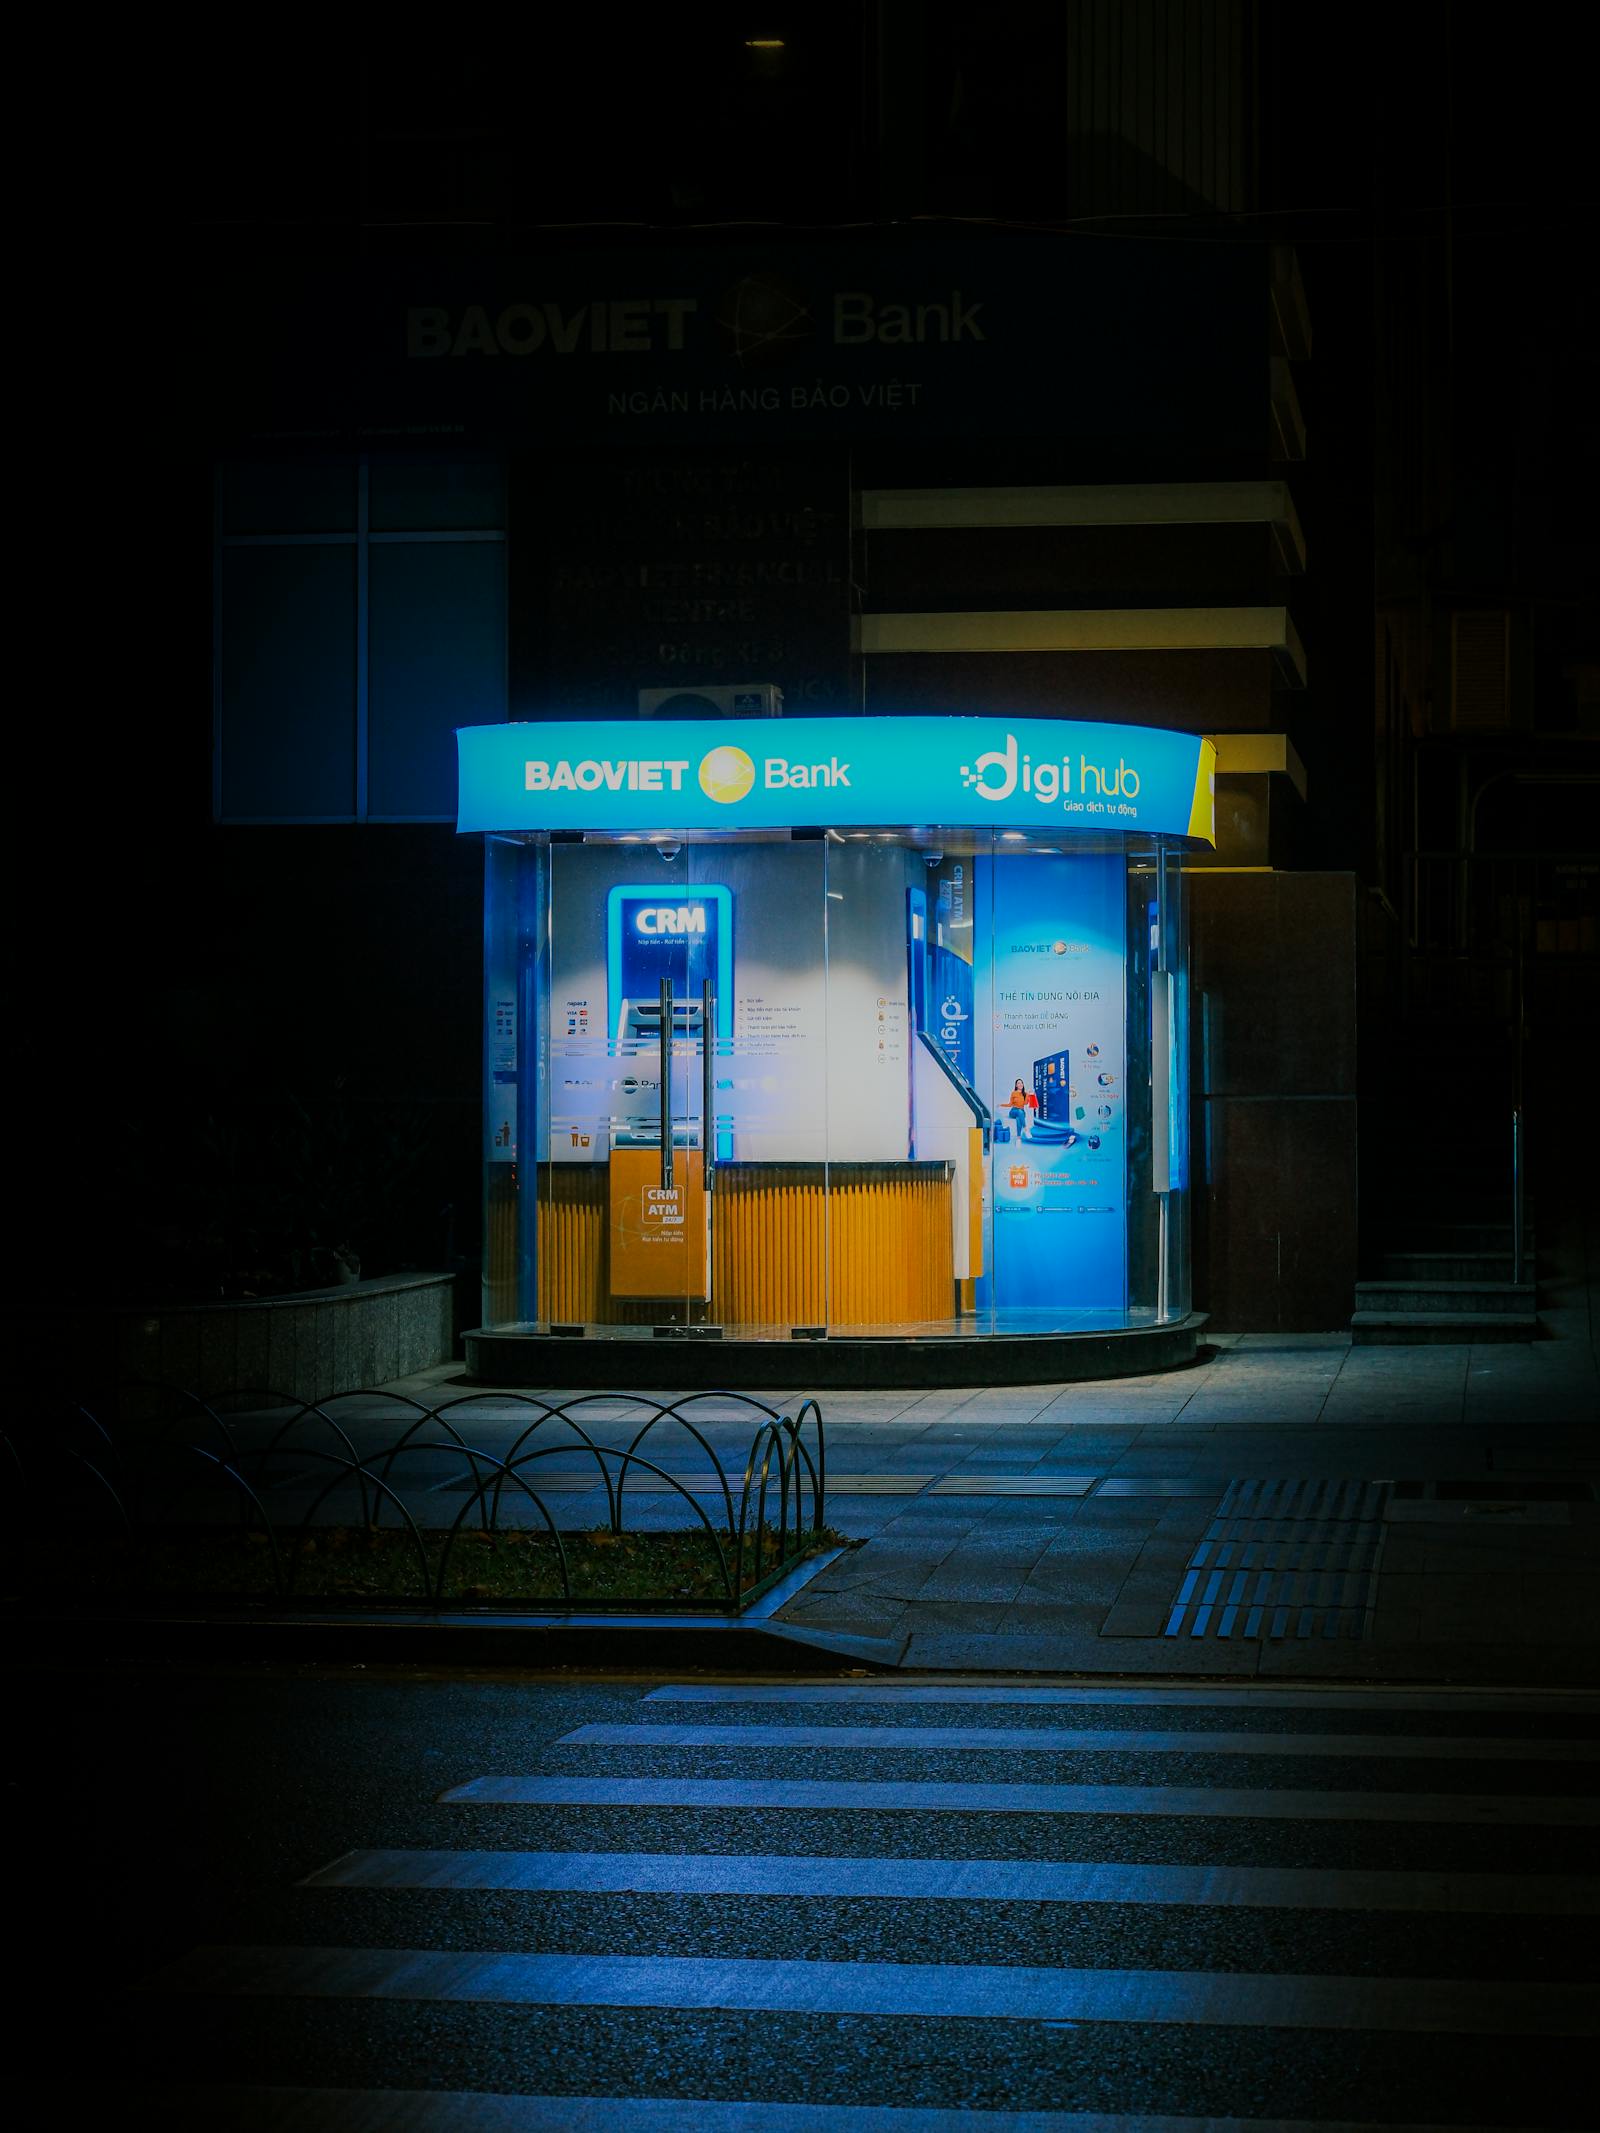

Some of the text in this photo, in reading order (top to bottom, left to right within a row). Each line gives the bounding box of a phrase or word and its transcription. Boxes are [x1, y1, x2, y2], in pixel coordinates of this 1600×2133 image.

[407, 290, 986, 359] BAOVIET Bank
[608, 377, 922, 416] NGÂN HÀNG BẢO VIỆT
[525, 734, 1139, 802] BAOVIET Bank digi hub
[1063, 800, 1137, 817] Giao dịch tự động
[637, 907, 706, 934] CRM
[1011, 945, 1052, 953] BAOVIET
[647, 1190, 678, 1200] CRM
[648, 1204, 678, 1216] ATM
